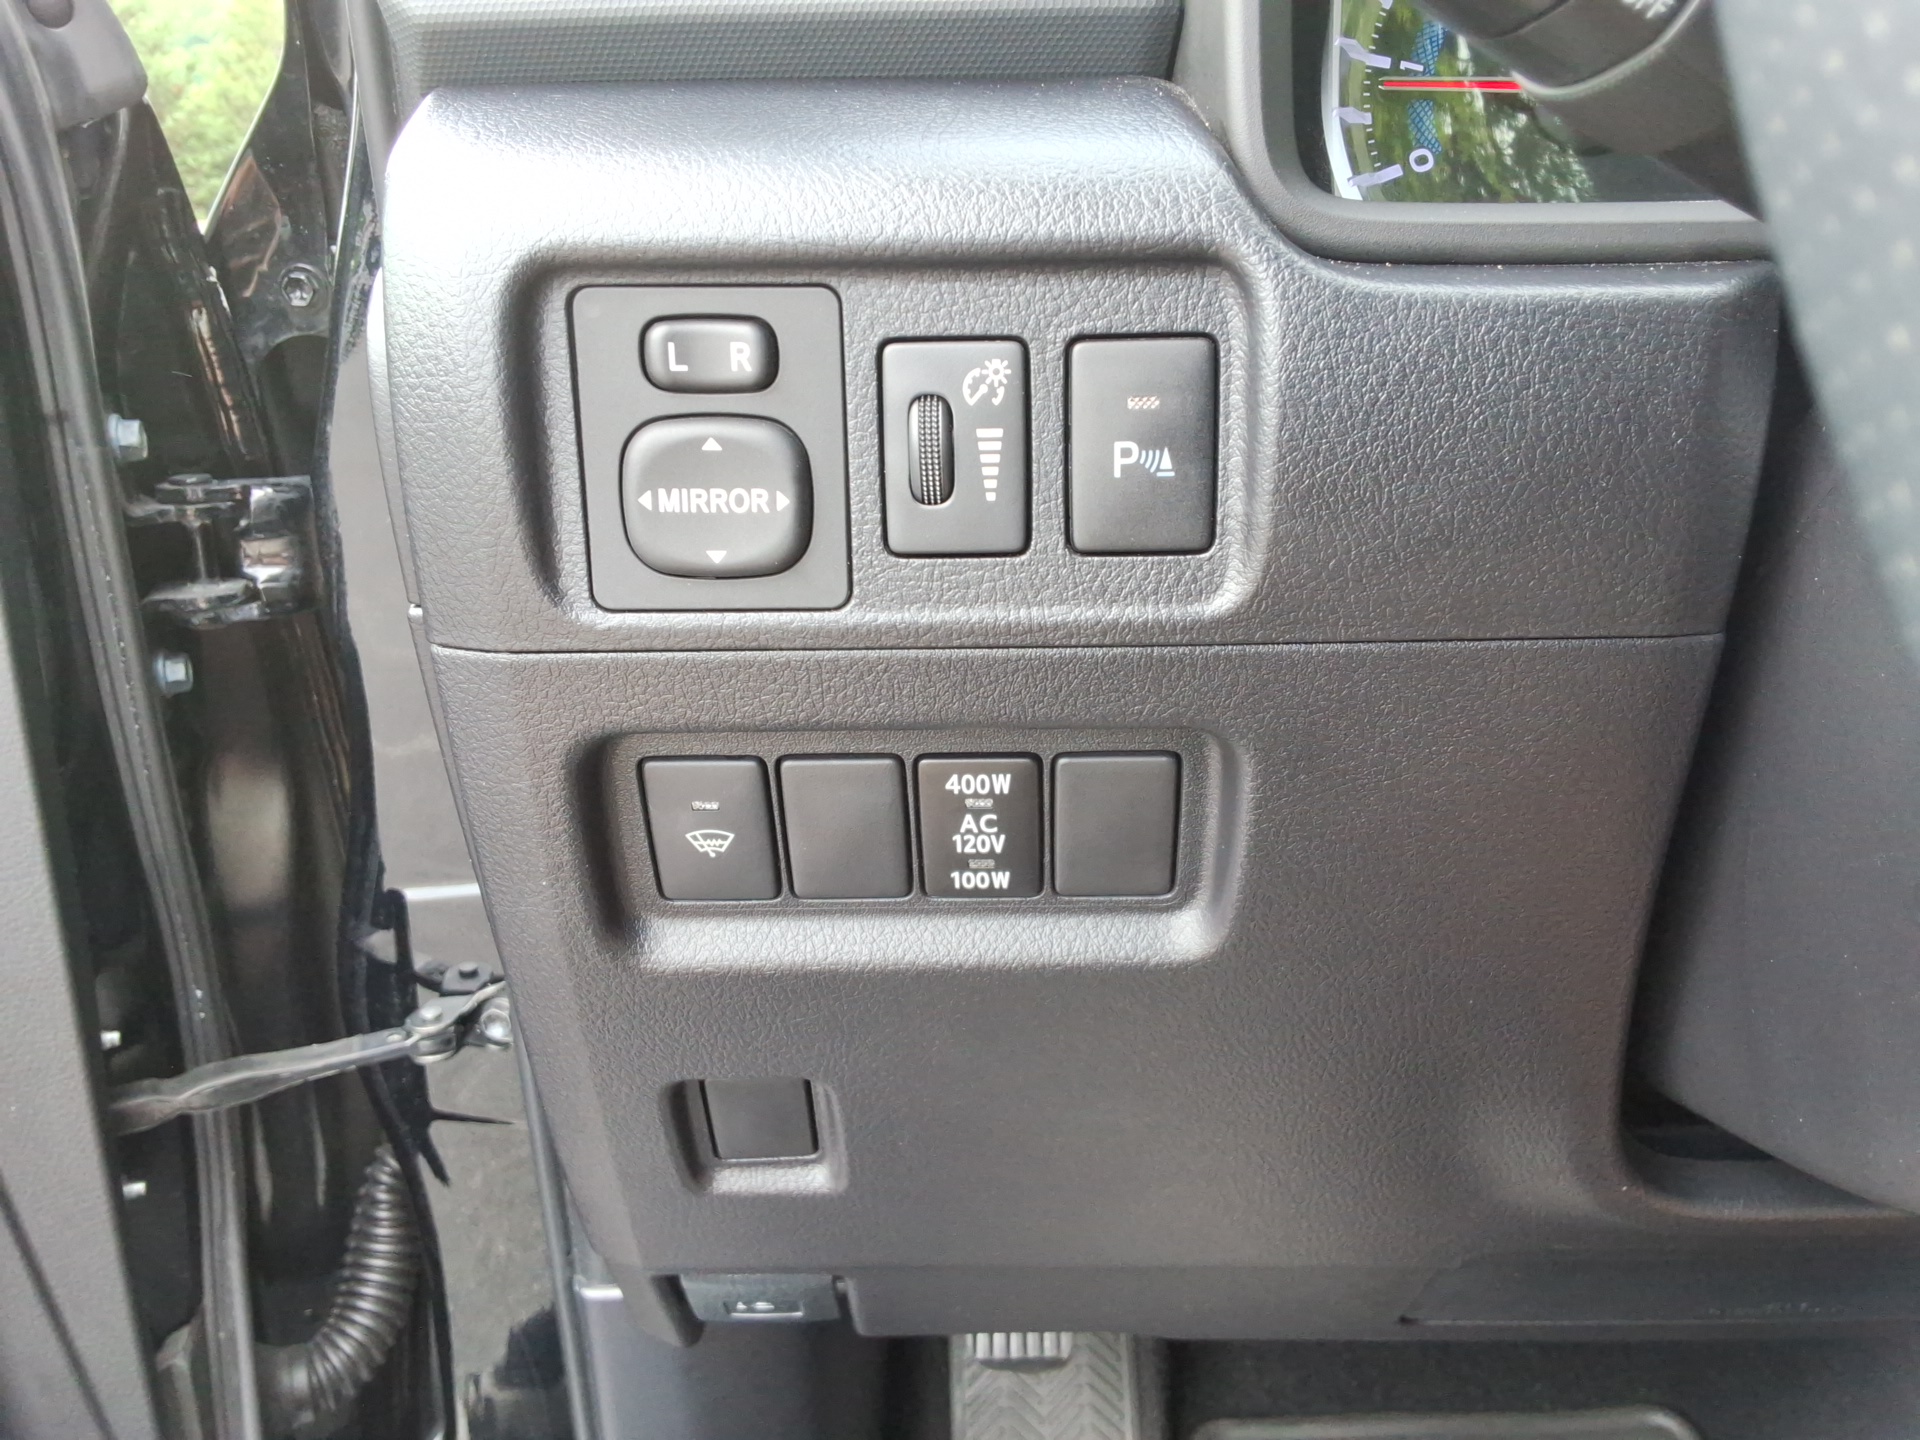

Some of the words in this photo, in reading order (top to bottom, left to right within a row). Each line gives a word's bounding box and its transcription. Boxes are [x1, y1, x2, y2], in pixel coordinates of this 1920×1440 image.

[667, 341, 689, 372] L
[729, 341, 752, 372] R
[1113, 441, 1140, 478] P
[657, 487, 770, 514] MIRROR
[944, 773, 1011, 795] 400W
[959, 813, 998, 833] AC
[952, 834, 1005, 853] 120V
[950, 871, 1010, 889] 100W
